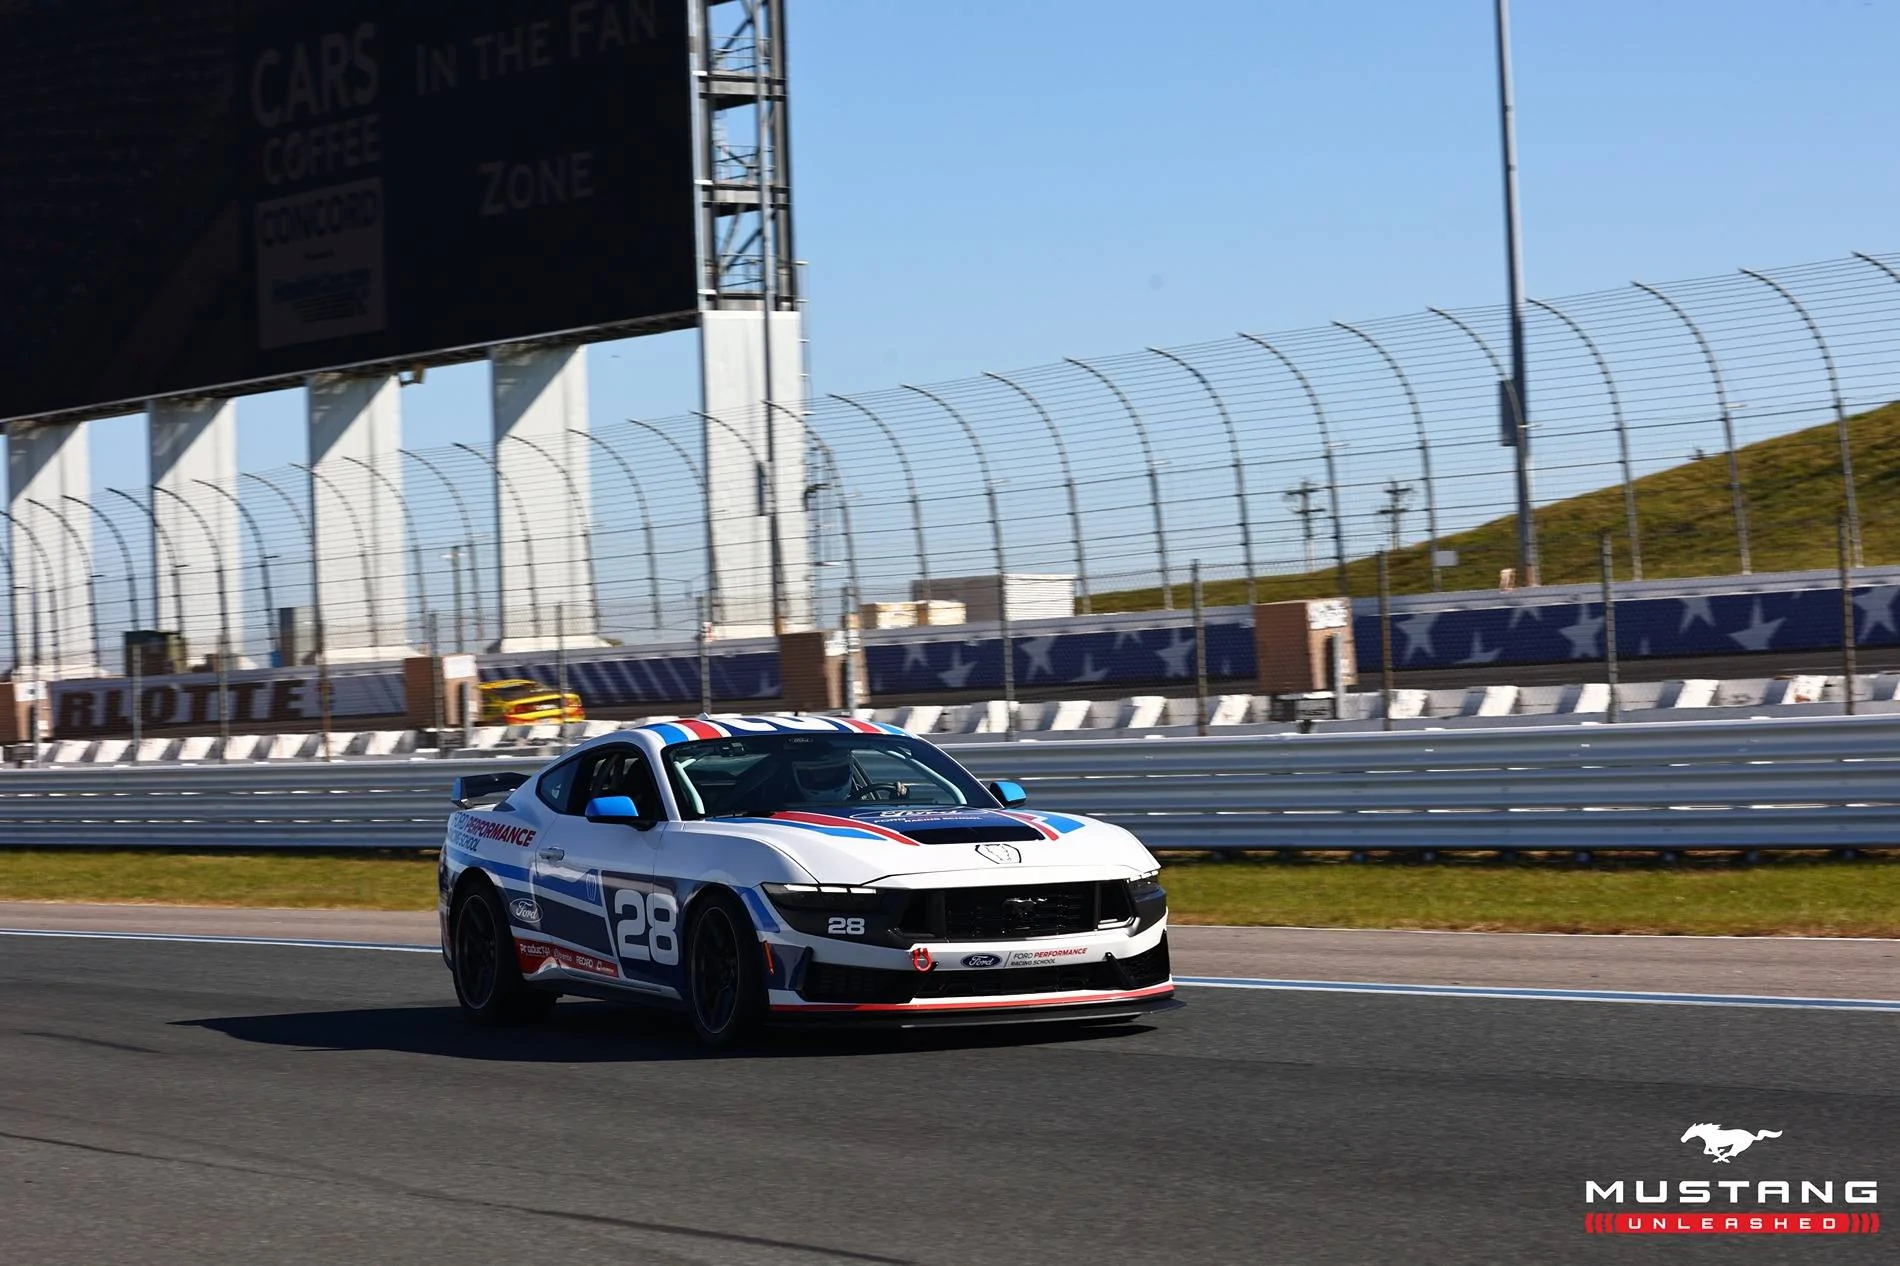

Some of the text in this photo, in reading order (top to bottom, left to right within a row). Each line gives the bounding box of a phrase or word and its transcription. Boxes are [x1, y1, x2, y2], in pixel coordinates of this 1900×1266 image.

[415, 0, 657, 96] IN THE FAN
[251, 21, 379, 128] CARS
[261, 112, 381, 185] COFFEE
[476, 150, 596, 217] ZONE
[261, 188, 378, 248] CONCORD
[464, 816, 537, 847] PERFORMANCE
[515, 900, 538, 920] Ford
[614, 889, 680, 966] 28
[827, 917, 866, 936] 28
[968, 955, 994, 967] Ford
[1014, 947, 1088, 960] FORD PERFORMANCE
[1033, 958, 1056, 966] SCHOOL
